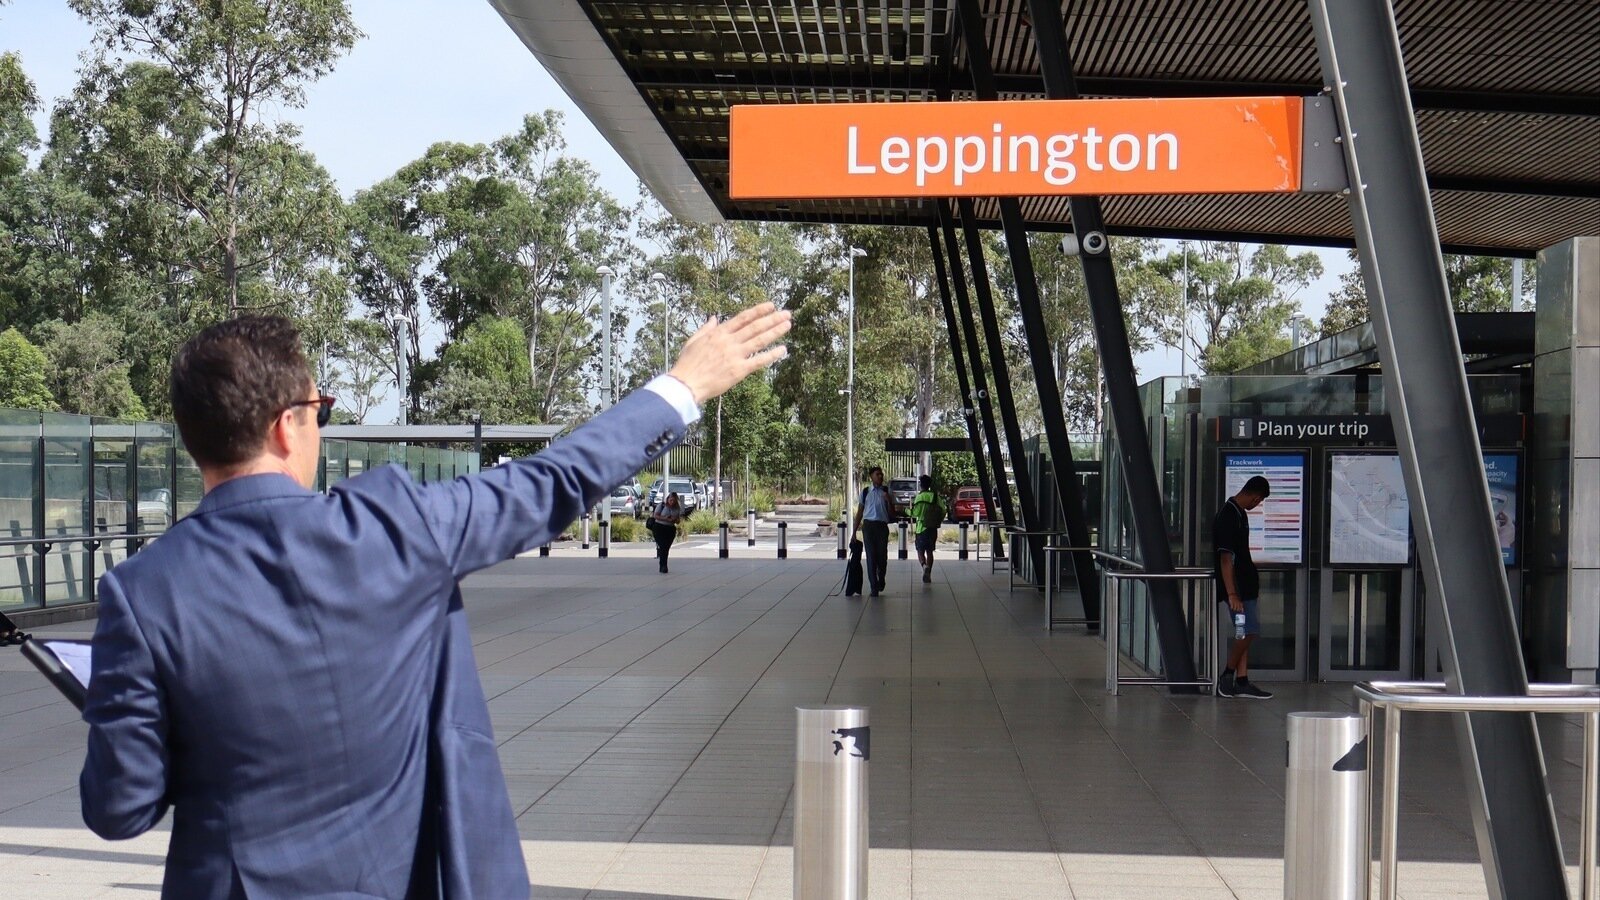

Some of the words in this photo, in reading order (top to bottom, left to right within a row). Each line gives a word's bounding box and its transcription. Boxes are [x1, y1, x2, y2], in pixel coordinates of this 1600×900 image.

[847, 123, 1179, 187] Leppington
[1257, 421, 1294, 436] Plan
[1297, 424, 1336, 439] your
[1338, 421, 1369, 439] trip
[1486, 470, 1507, 478] pacity
